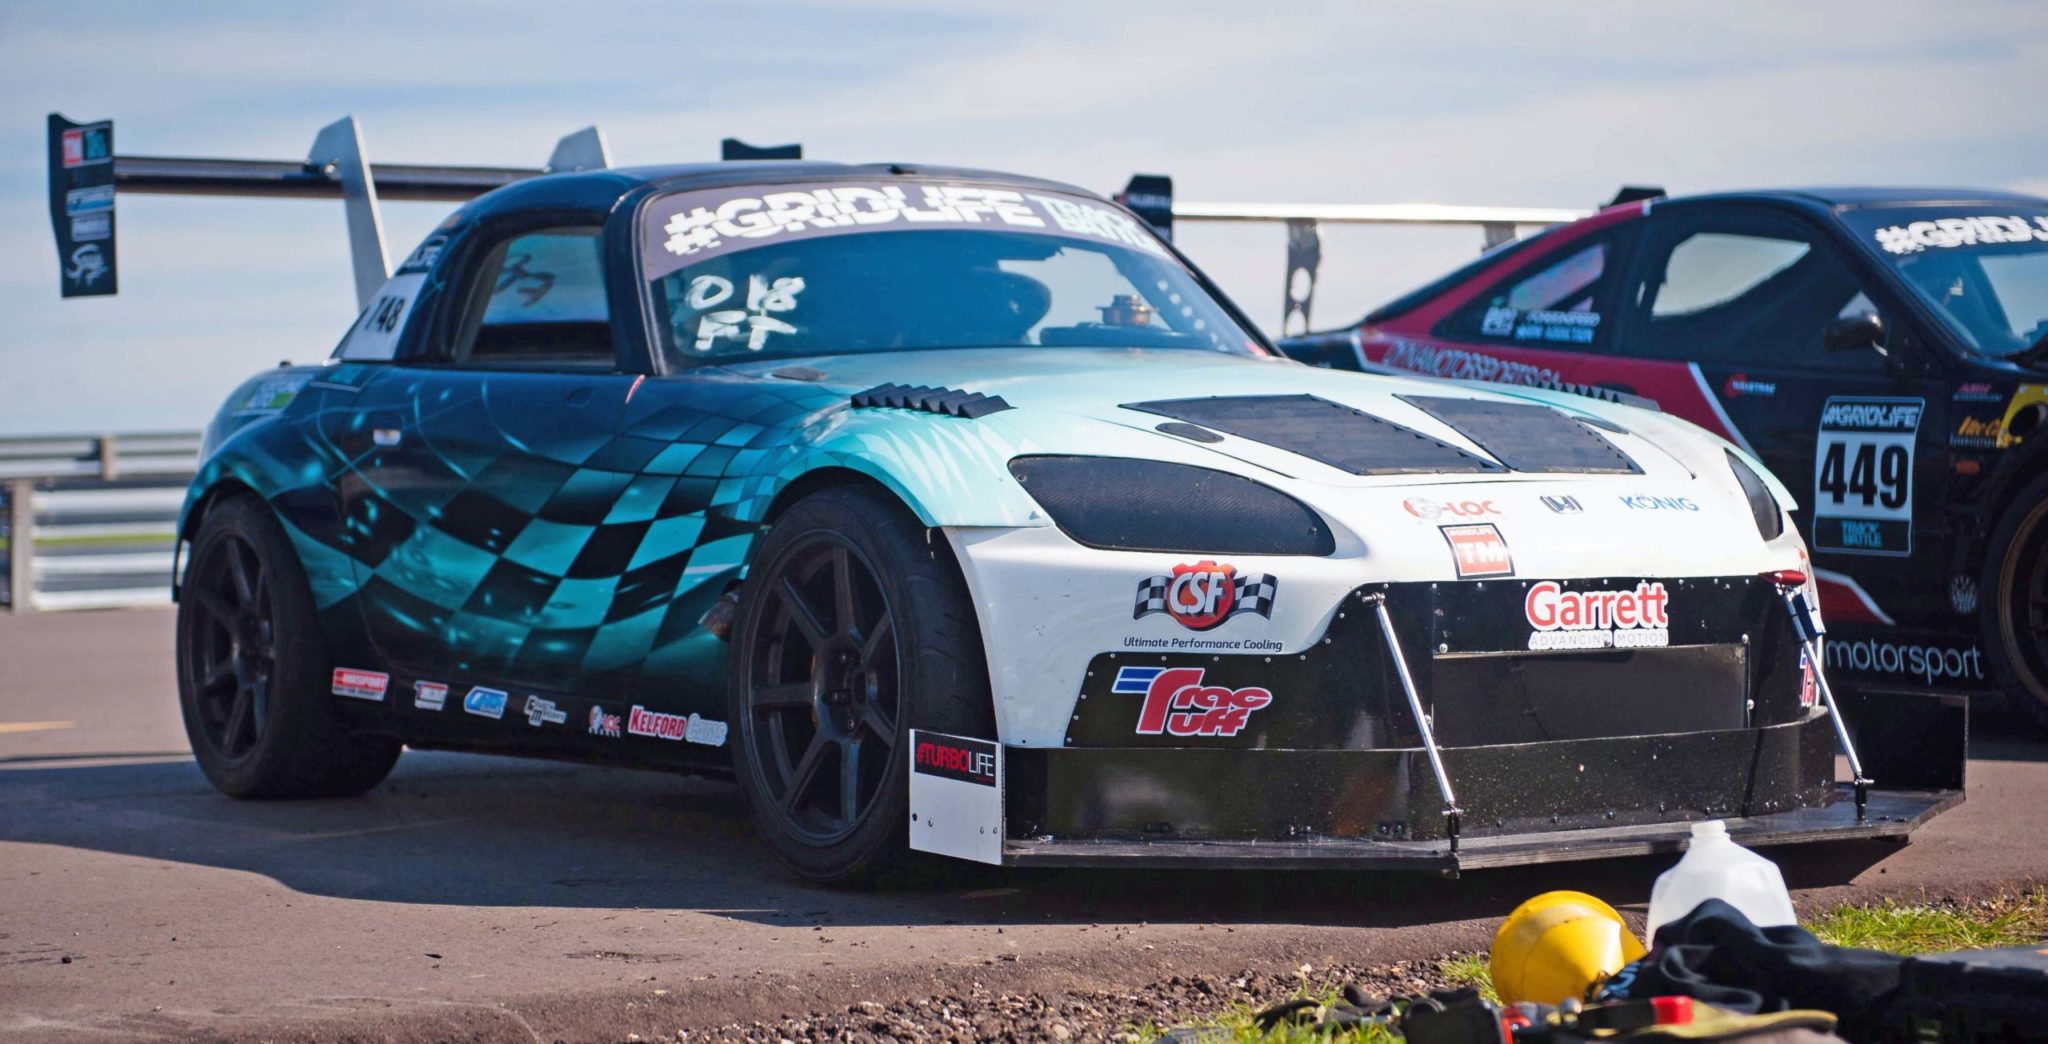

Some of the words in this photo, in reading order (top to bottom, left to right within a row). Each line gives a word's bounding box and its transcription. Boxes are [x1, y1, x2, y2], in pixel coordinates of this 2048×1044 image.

[663, 186, 1046, 256] #GRIDLIFE
[1823, 404, 1920, 427] #GRIDLIFE
[1819, 442, 1910, 509] 449
[1169, 571, 1226, 616] CSF
[1526, 584, 1667, 627] Garrett
[1124, 636, 1169, 649] Ultimate
[1171, 637, 1241, 650] Performance
[1243, 639, 1283, 652] Cooling
[1531, 633, 1610, 647] ADVANCING
[1616, 632, 1668, 644] MOTION
[1824, 637, 1984, 686] motorsport
[630, 706, 687, 739] KELFORD
